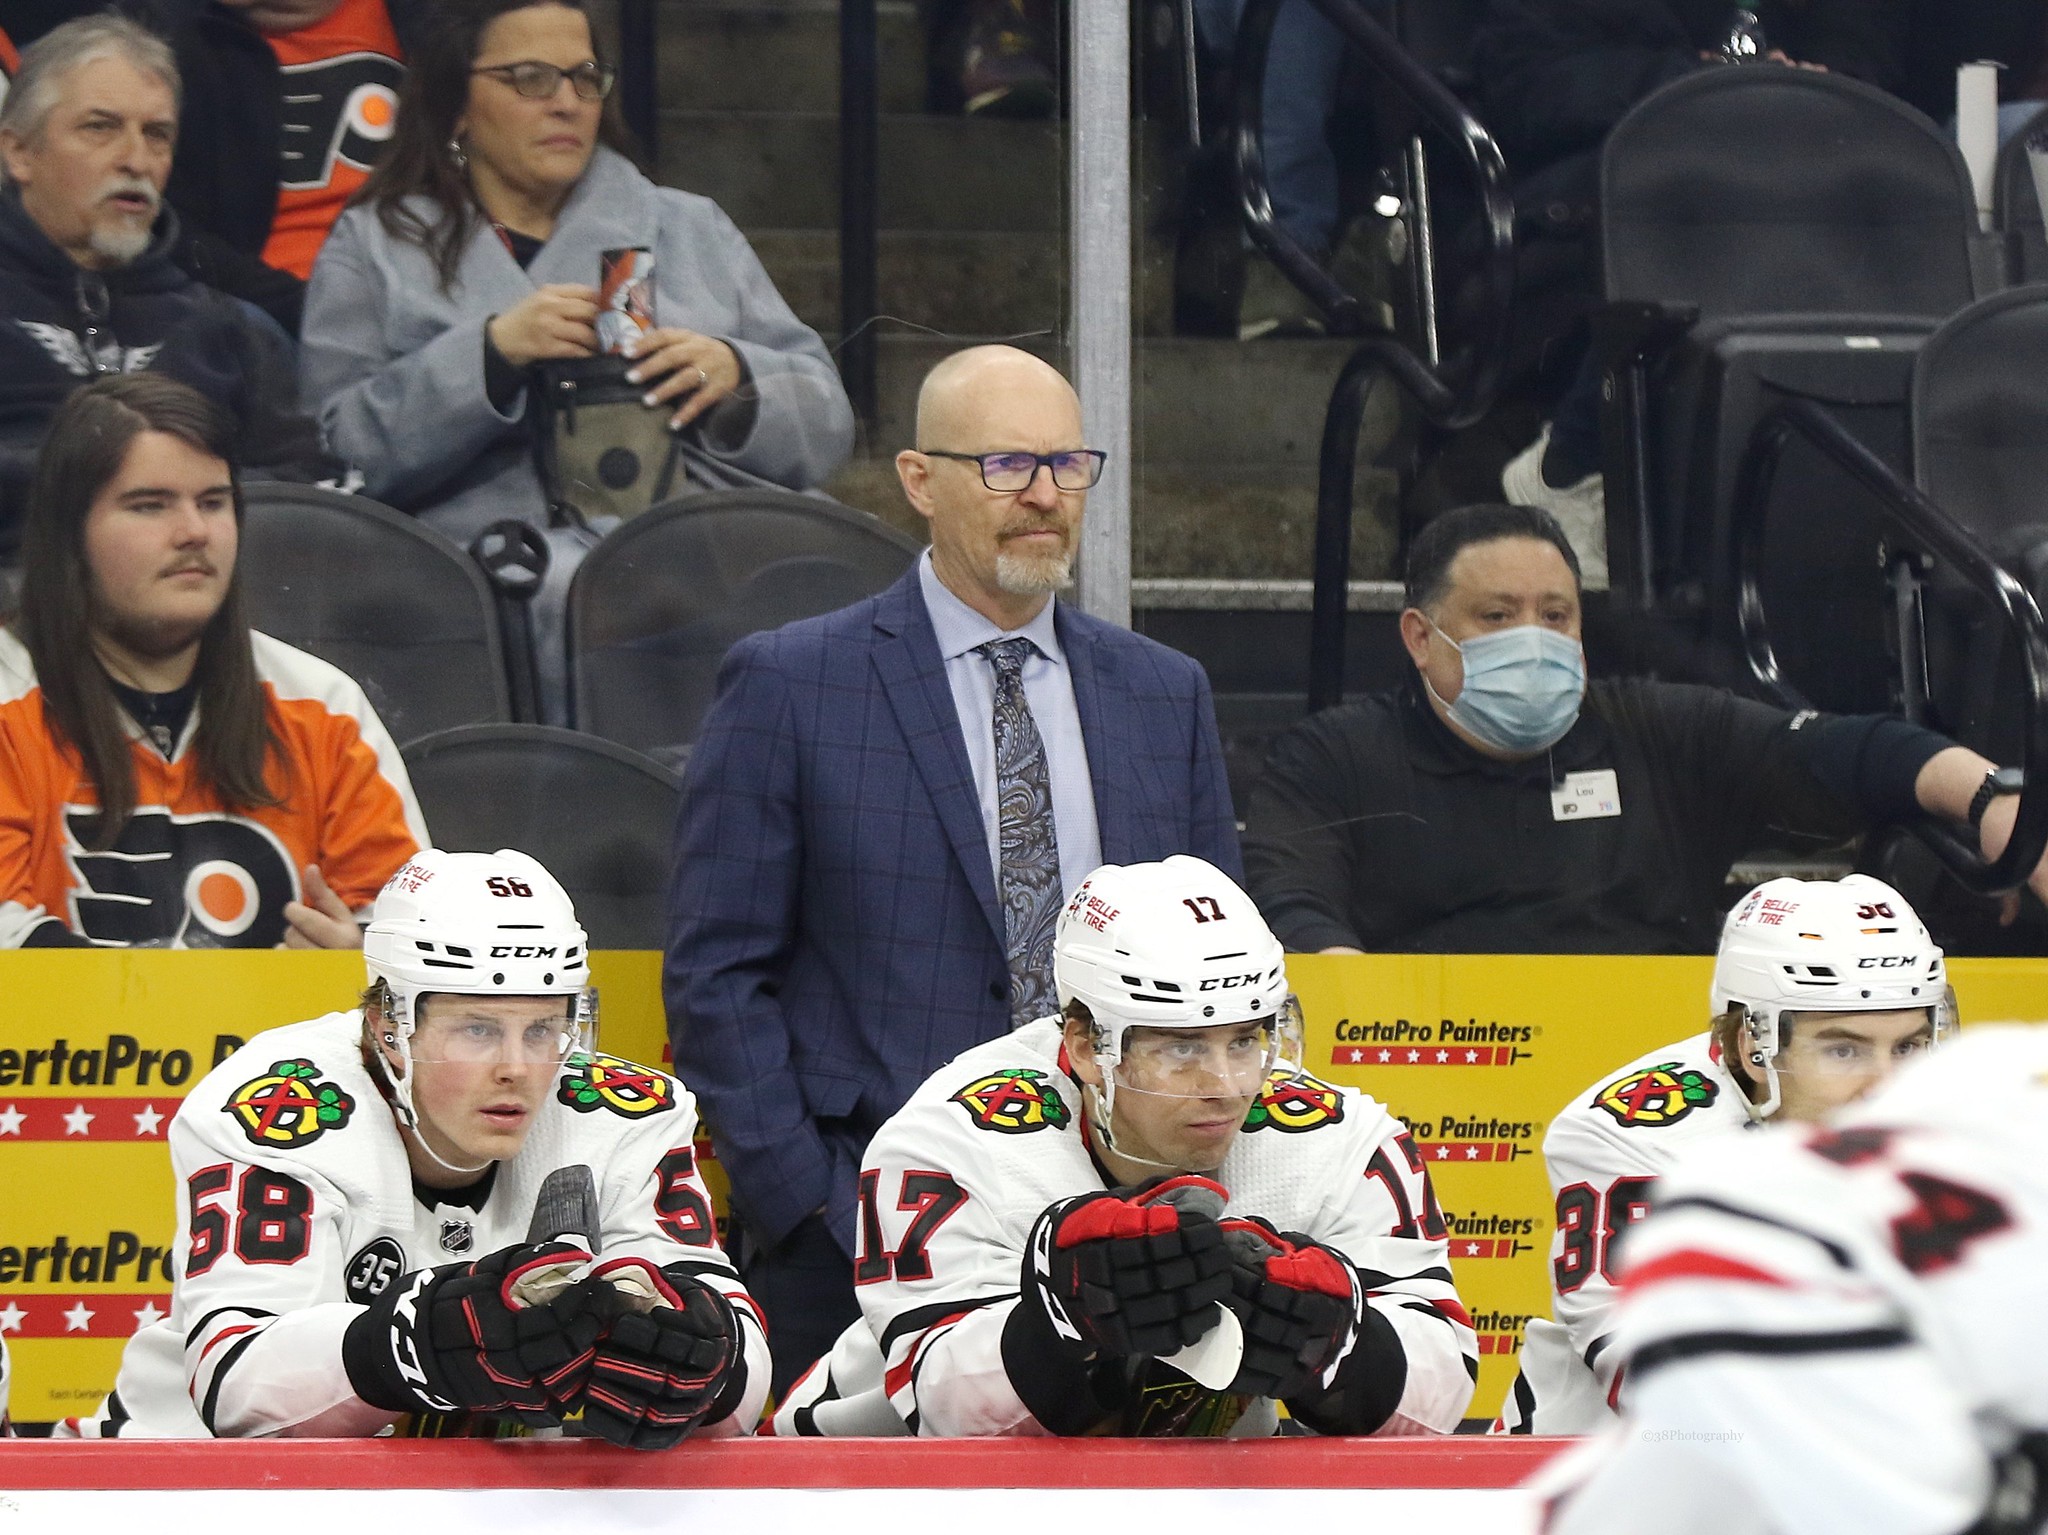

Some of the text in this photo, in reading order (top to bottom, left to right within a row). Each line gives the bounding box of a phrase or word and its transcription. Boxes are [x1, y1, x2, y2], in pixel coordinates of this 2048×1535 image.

[399, 877, 422, 893] TIRE
[406, 865, 436, 883] BELLE
[1087, 895, 1120, 921] BELLE
[1183, 896, 1227, 923] 17
[1761, 899, 1800, 913] BELLE
[1083, 911, 1108, 933] TIRE
[1757, 912, 1786, 925] TIRE
[489, 946, 559, 959] CCM
[1857, 955, 1918, 969] CCM
[1199, 972, 1263, 992] CCM
[1335, 1018, 1532, 1042] CertaPro Painters
[0, 1035, 193, 1086] ertaPro
[1440, 1114, 1533, 1138] Painters
[186, 1162, 314, 1279] 58
[854, 1168, 969, 1286] 17
[1443, 1211, 1533, 1235] Painters
[445, 1229, 468, 1248] NHL
[0, 1230, 175, 1283] ertaPr
[352, 1252, 399, 1296] 35
